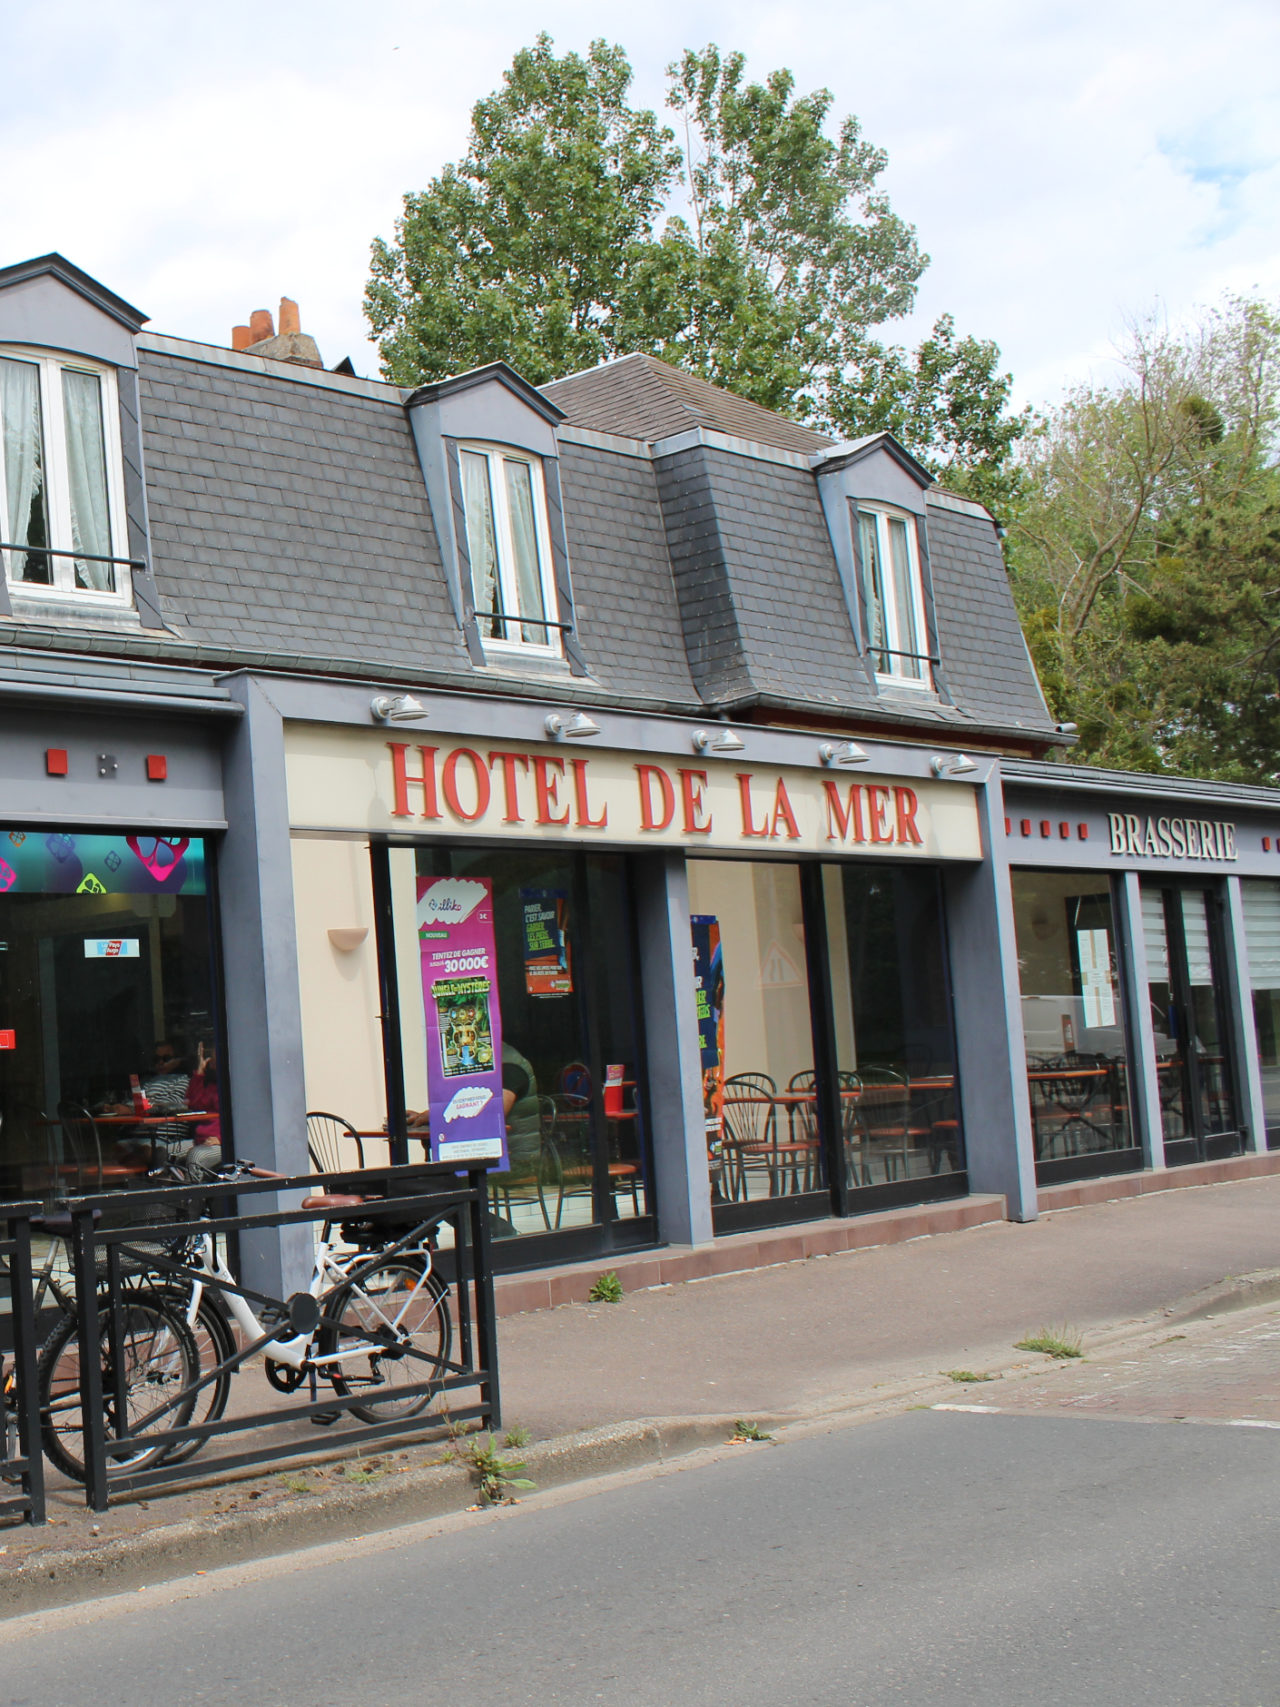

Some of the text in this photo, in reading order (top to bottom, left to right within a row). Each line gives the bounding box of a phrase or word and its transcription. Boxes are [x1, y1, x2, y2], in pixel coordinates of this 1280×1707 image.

[386, 741, 923, 845] HOTEL DE LA MER
[1107, 812, 1239, 860] BRASSERIE
[438, 897, 462, 911] illiko
[432, 952, 453, 960] TENTEZ
[462, 947, 486, 957] GAGNER
[444, 959, 458, 973] 30
